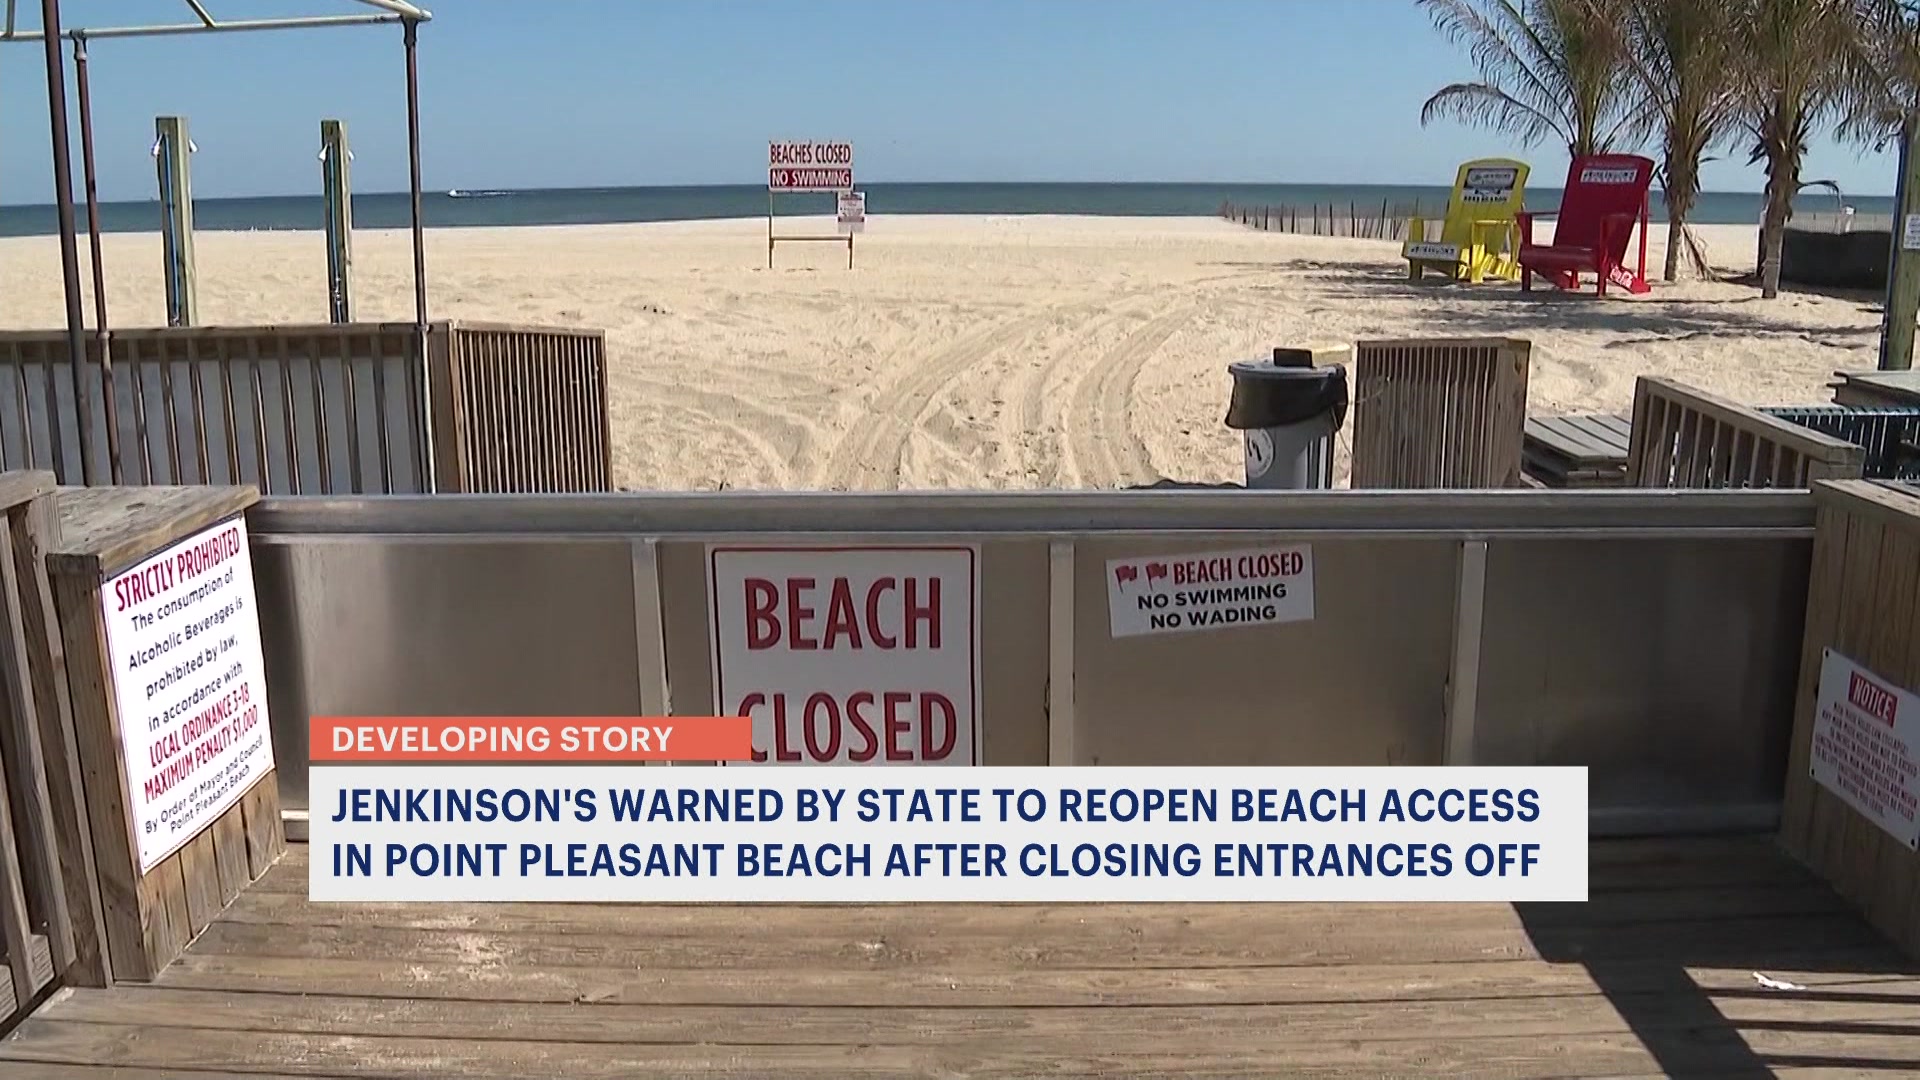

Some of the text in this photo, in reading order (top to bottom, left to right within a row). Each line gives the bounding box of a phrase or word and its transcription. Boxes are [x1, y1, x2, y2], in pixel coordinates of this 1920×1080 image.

[770, 144, 851, 164] BEACHES CLOSED
[772, 169, 850, 187] NO SWIMMING
[115, 527, 240, 612] STRICTLY PROHIBITED
[131, 566, 233, 632] The consumption of
[1137, 583, 1287, 609] NO SWIMMING
[1173, 551, 1303, 585] BEACH CLOSED
[129, 596, 243, 671] Alcoholic Beverages is
[744, 577, 941, 650] BEACH
[1151, 605, 1276, 629] NO WADING
[146, 635, 238, 700] prohibited by law,
[149, 661, 243, 732] in accordance with
[1853, 678, 1893, 723] NOTICE
[144, 704, 258, 804] MAXIMUM PENALTY $1,000
[149, 730, 181, 768] LOCAL
[182, 694, 232, 746] ORDINANCE
[737, 692, 957, 762] CLOSED
[145, 733, 263, 834] By Order of Mayor and Council
[170, 764, 250, 834] Point Pleasant Beach
